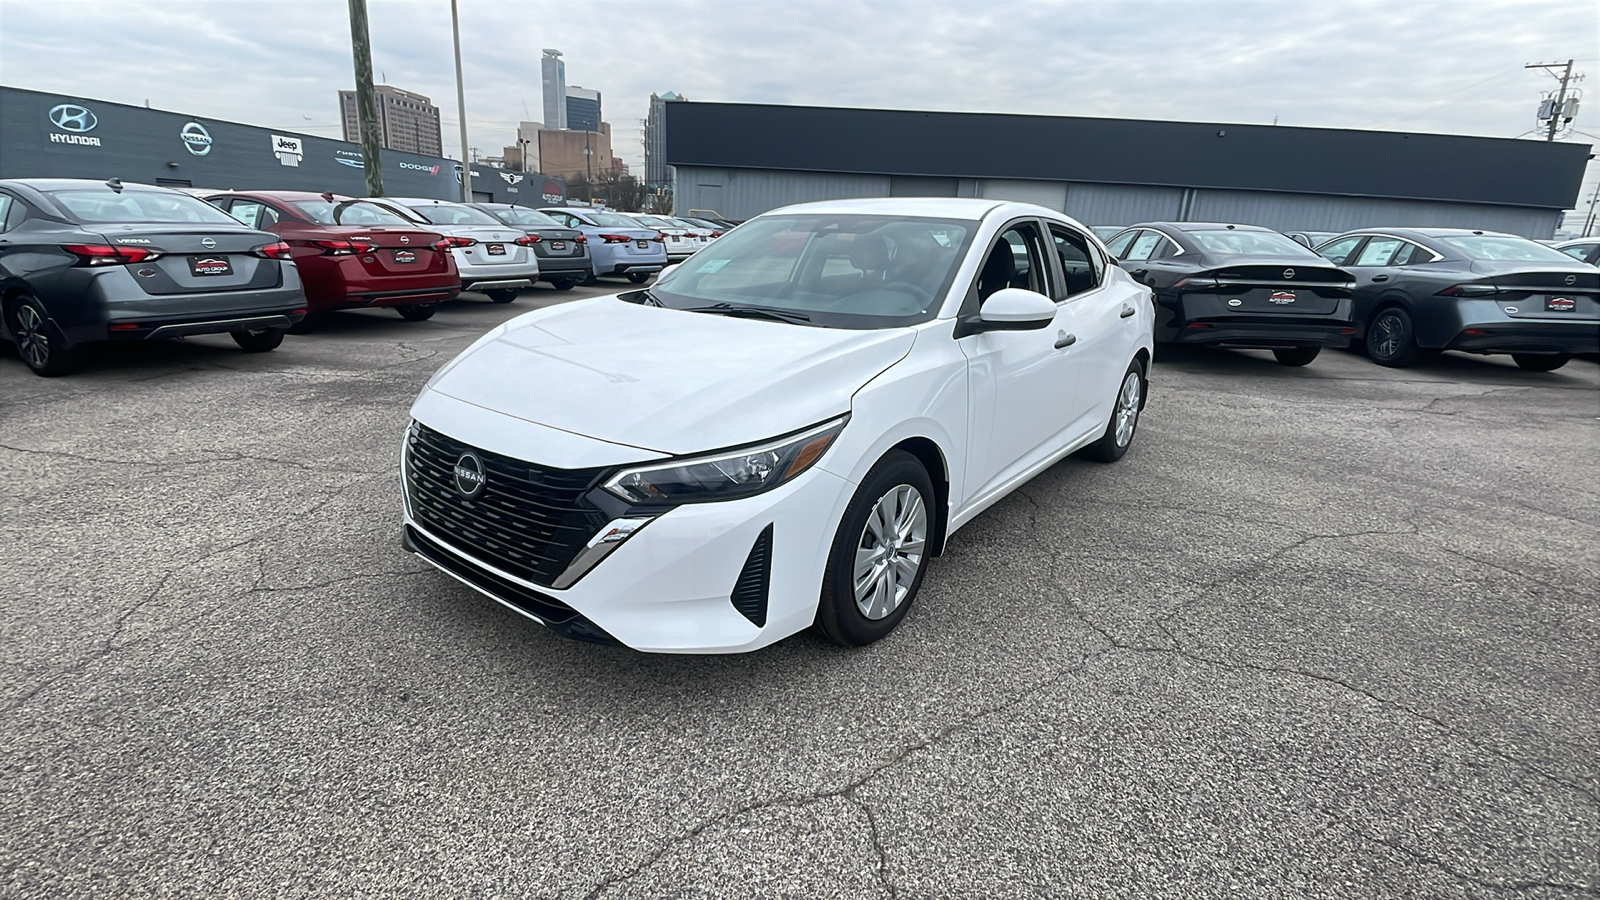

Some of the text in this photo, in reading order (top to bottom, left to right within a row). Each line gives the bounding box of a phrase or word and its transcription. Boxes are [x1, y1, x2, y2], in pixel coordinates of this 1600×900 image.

[50, 133, 101, 146] HYUNDAI
[183, 135, 210, 143] NISSAN
[277, 138, 297, 151] Jeep
[336, 150, 364, 158] CHRYS
[399, 162, 433, 172] DODGE
[454, 466, 484, 483] NISSAN
